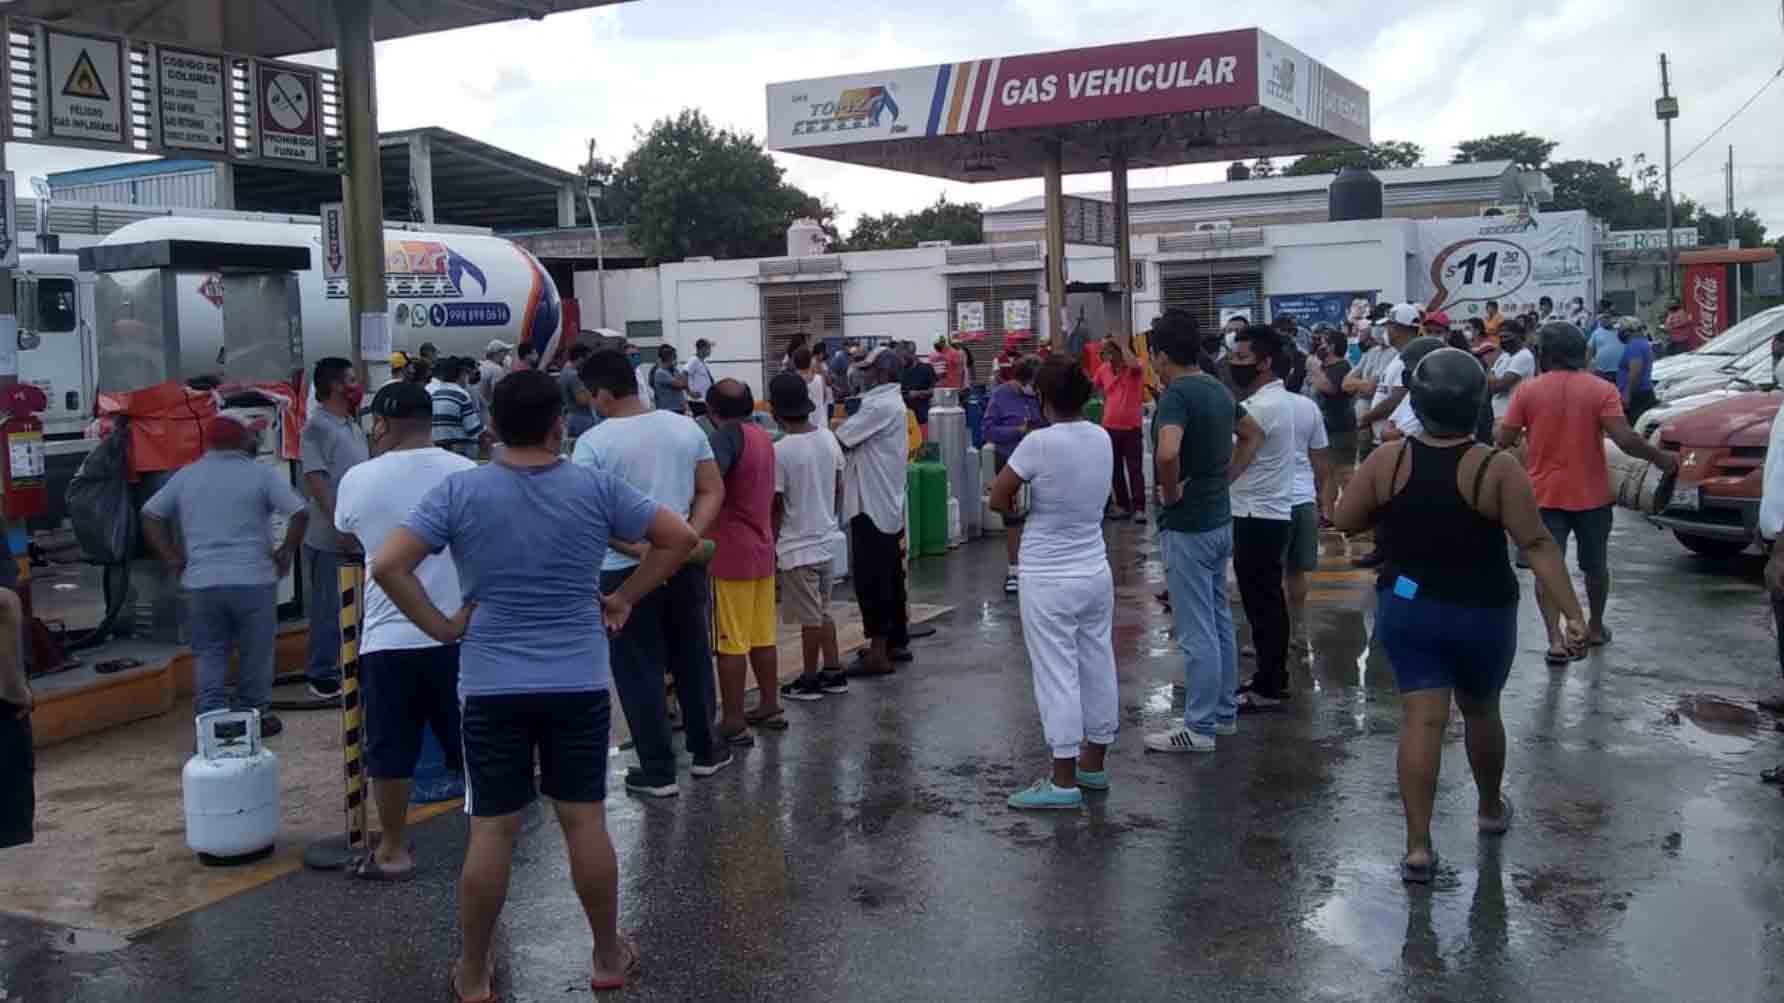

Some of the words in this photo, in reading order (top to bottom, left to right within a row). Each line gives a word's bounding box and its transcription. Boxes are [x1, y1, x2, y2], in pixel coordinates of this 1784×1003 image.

[1000, 74, 1059, 106] GAS
[1066, 55, 1238, 99] VEHICULAR
[264, 134, 314, 147] PROHIBIDO
[273, 145, 305, 157] FUMAR
